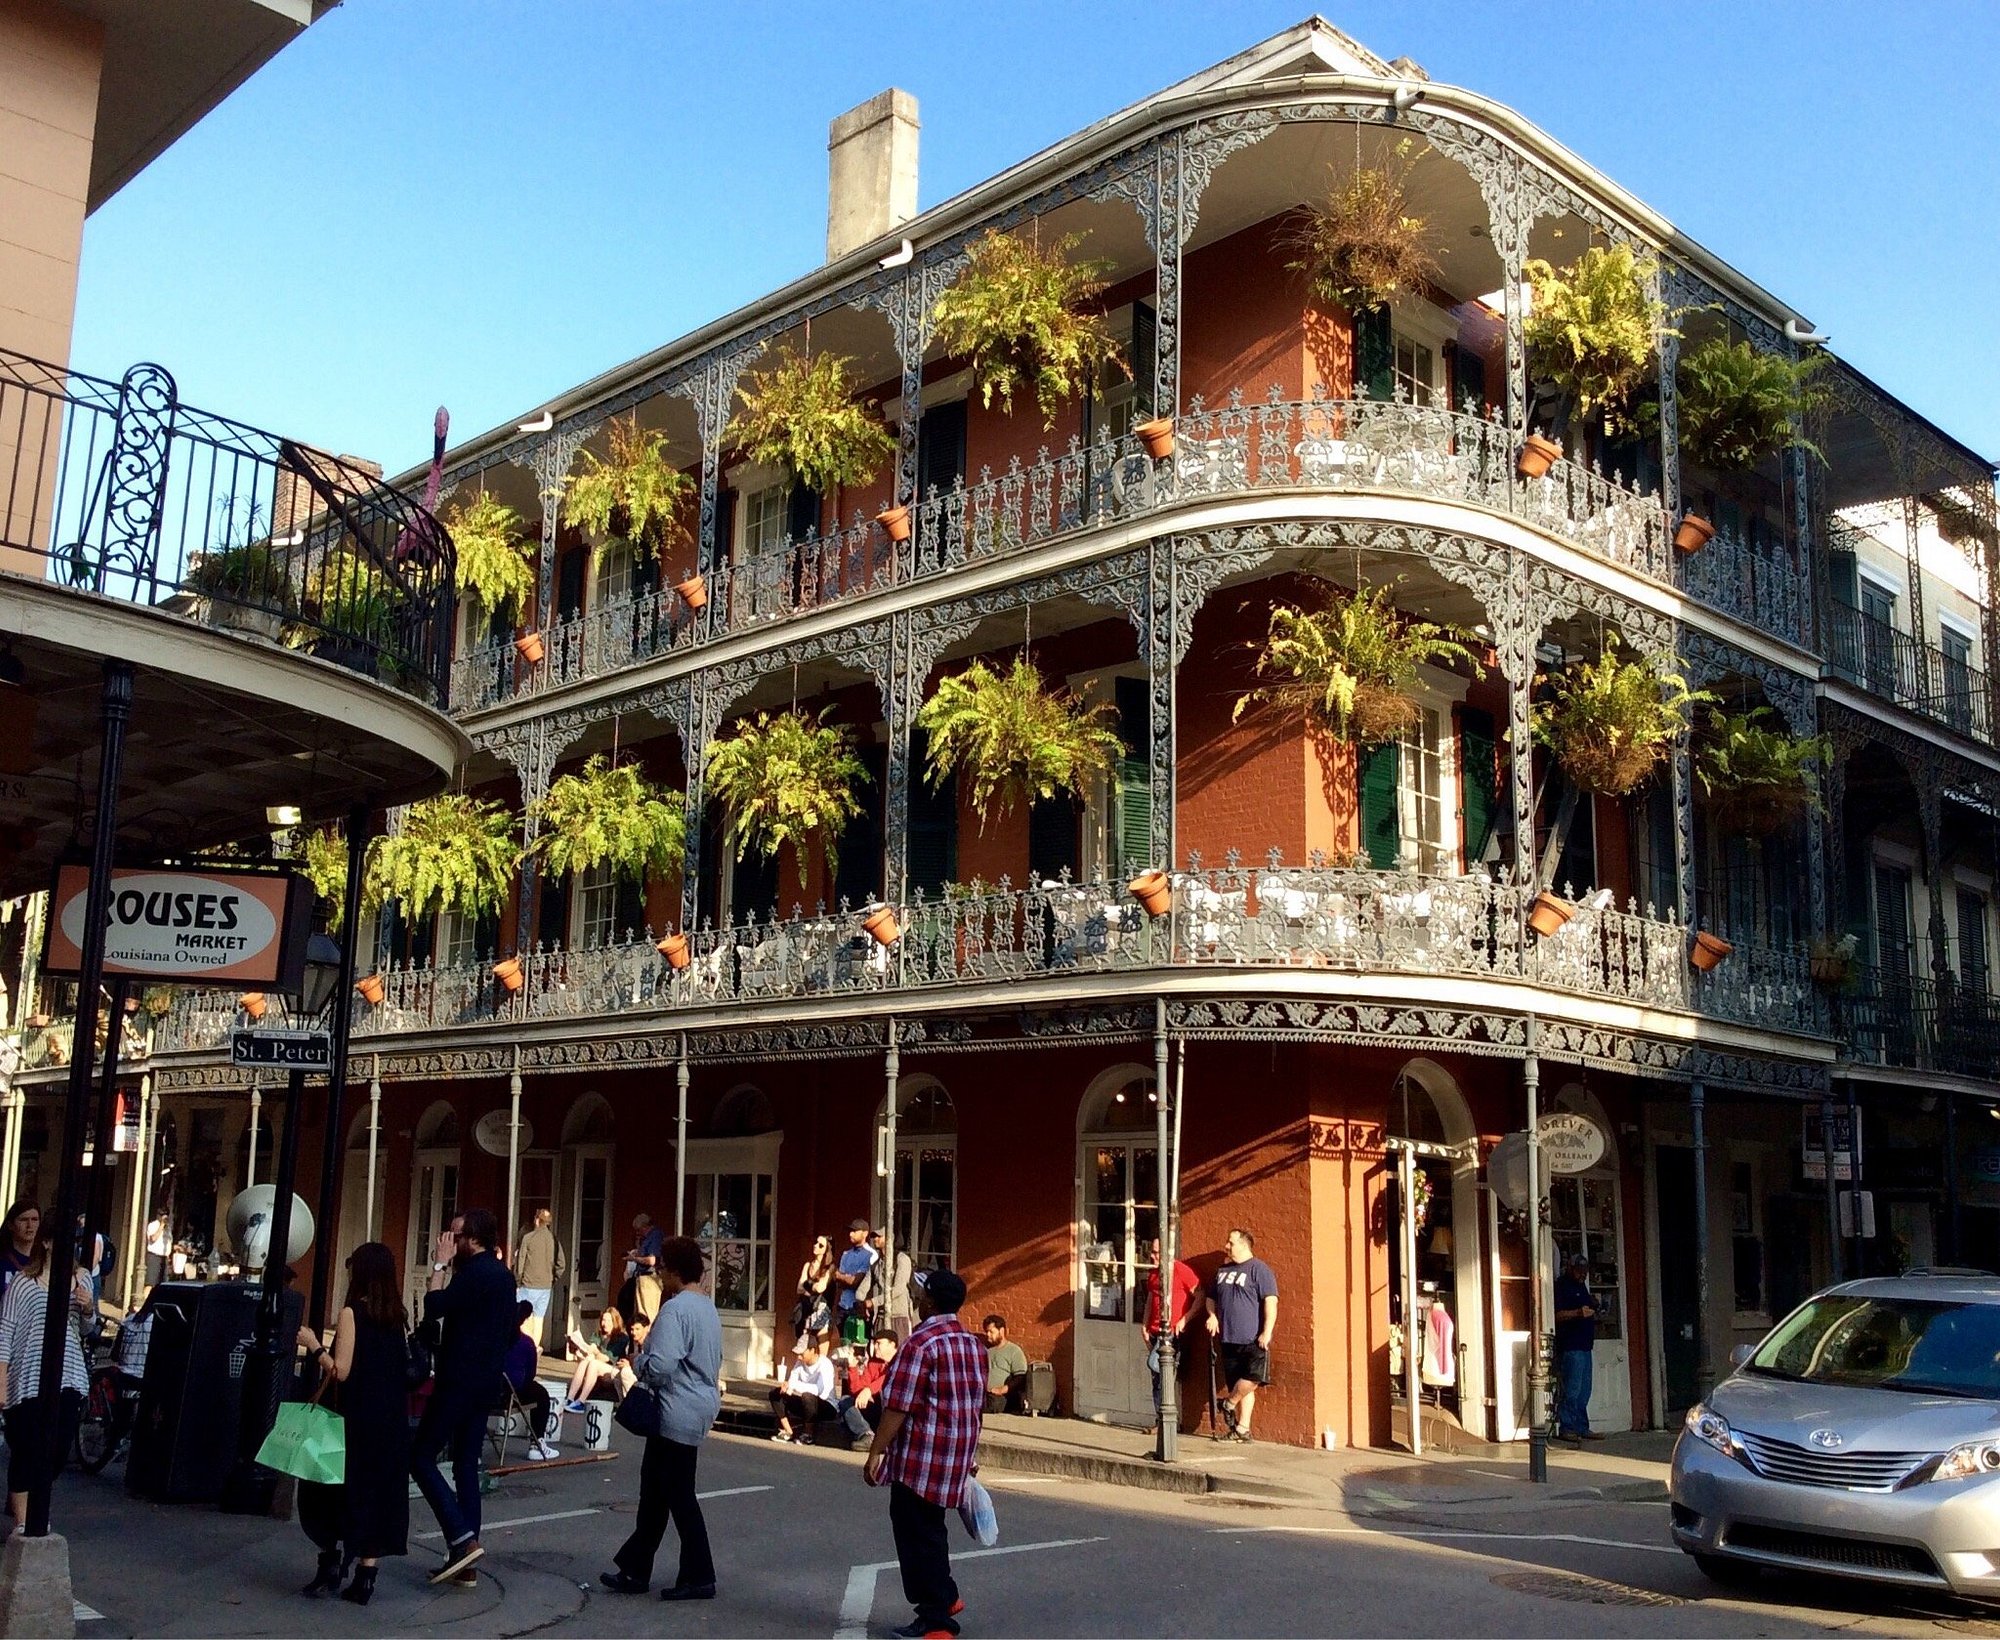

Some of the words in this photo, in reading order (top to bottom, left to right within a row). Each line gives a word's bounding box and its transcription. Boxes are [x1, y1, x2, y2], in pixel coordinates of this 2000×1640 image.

[175, 933, 248, 950] MARKET
[174, 950, 227, 965] Owned
[235, 1040, 262, 1059] St.
[271, 1041, 326, 1061] Peter
[1538, 1118, 1593, 1140] OREVER
[1554, 1151, 1593, 1161] ORLEANS
[1217, 1270, 1247, 1288] USA
